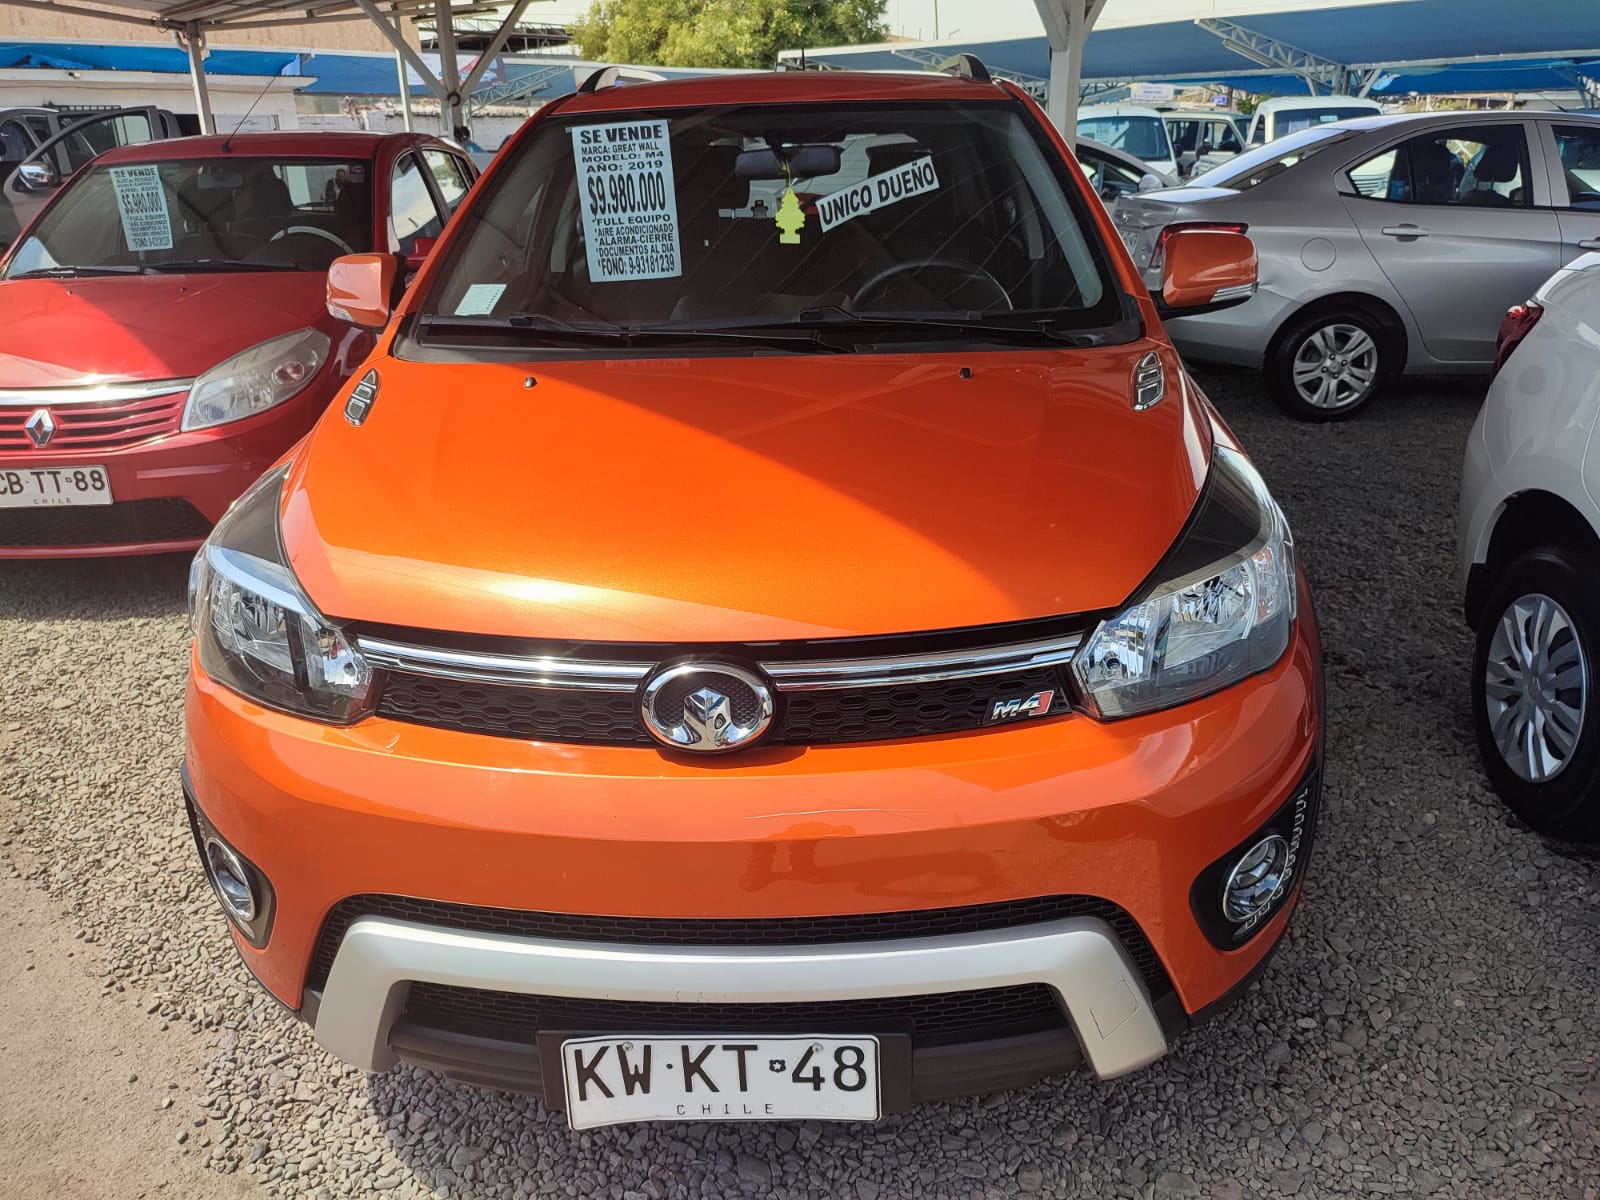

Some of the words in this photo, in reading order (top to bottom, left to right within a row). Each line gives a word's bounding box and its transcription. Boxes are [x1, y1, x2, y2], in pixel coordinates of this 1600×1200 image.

[581, 129, 602, 144] SE
[605, 125, 662, 142] VENDE
[581, 145, 610, 155] MARCA:
[613, 144, 636, 153] GREAT
[639, 141, 659, 151] WALL
[582, 153, 641, 163] MODELO:
[645, 150, 664, 159] M4
[114, 169, 126, 178] SE
[127, 167, 157, 177] VENDE
[586, 162, 623, 173] AÑO:
[628, 160, 663, 170] 2019
[587, 171, 666, 217] $9.980.000
[821, 185, 872, 225] UNICO
[877, 162, 935, 202] DUEÑO
[628, 214, 671, 224] EQUIPO
[616, 223, 674, 236] ACONDICIONADO
[651, 245, 660, 254] AL
[662, 243, 674, 253] DIA
[629, 254, 675, 275] 9-93181239
[677, 1103, 774, 1116] CHILE
